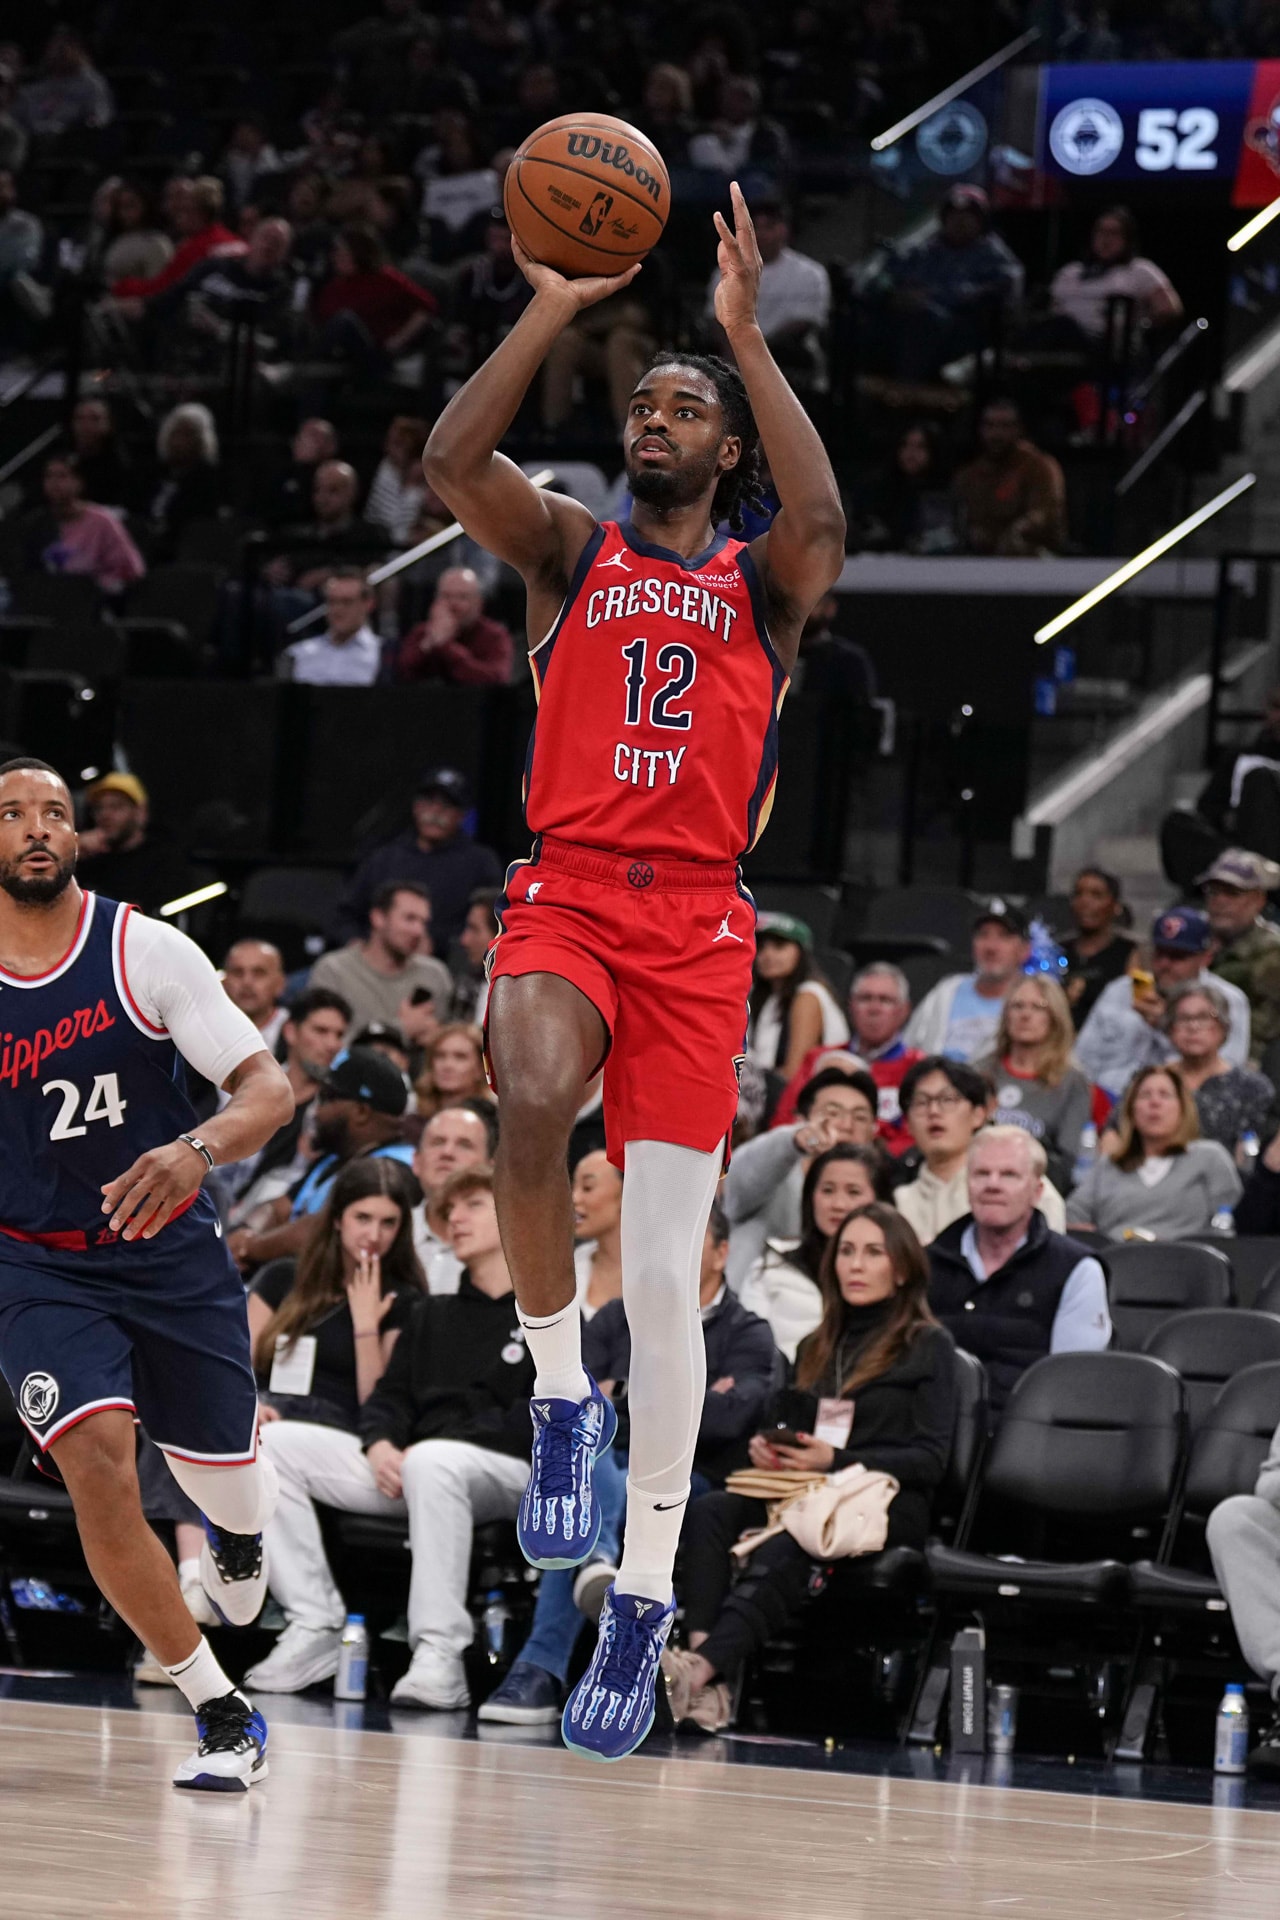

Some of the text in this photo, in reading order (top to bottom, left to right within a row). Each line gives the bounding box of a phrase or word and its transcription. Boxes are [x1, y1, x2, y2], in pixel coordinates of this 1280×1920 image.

[567, 132, 661, 203] Wilson
[1135, 107, 1219, 171] 52
[585, 578, 738, 643] CRESCENT
[621, 637, 697, 731] 12
[613, 742, 688, 788] CITY
[0, 998, 116, 1089] ippers
[41, 1072, 128, 1141] 24
